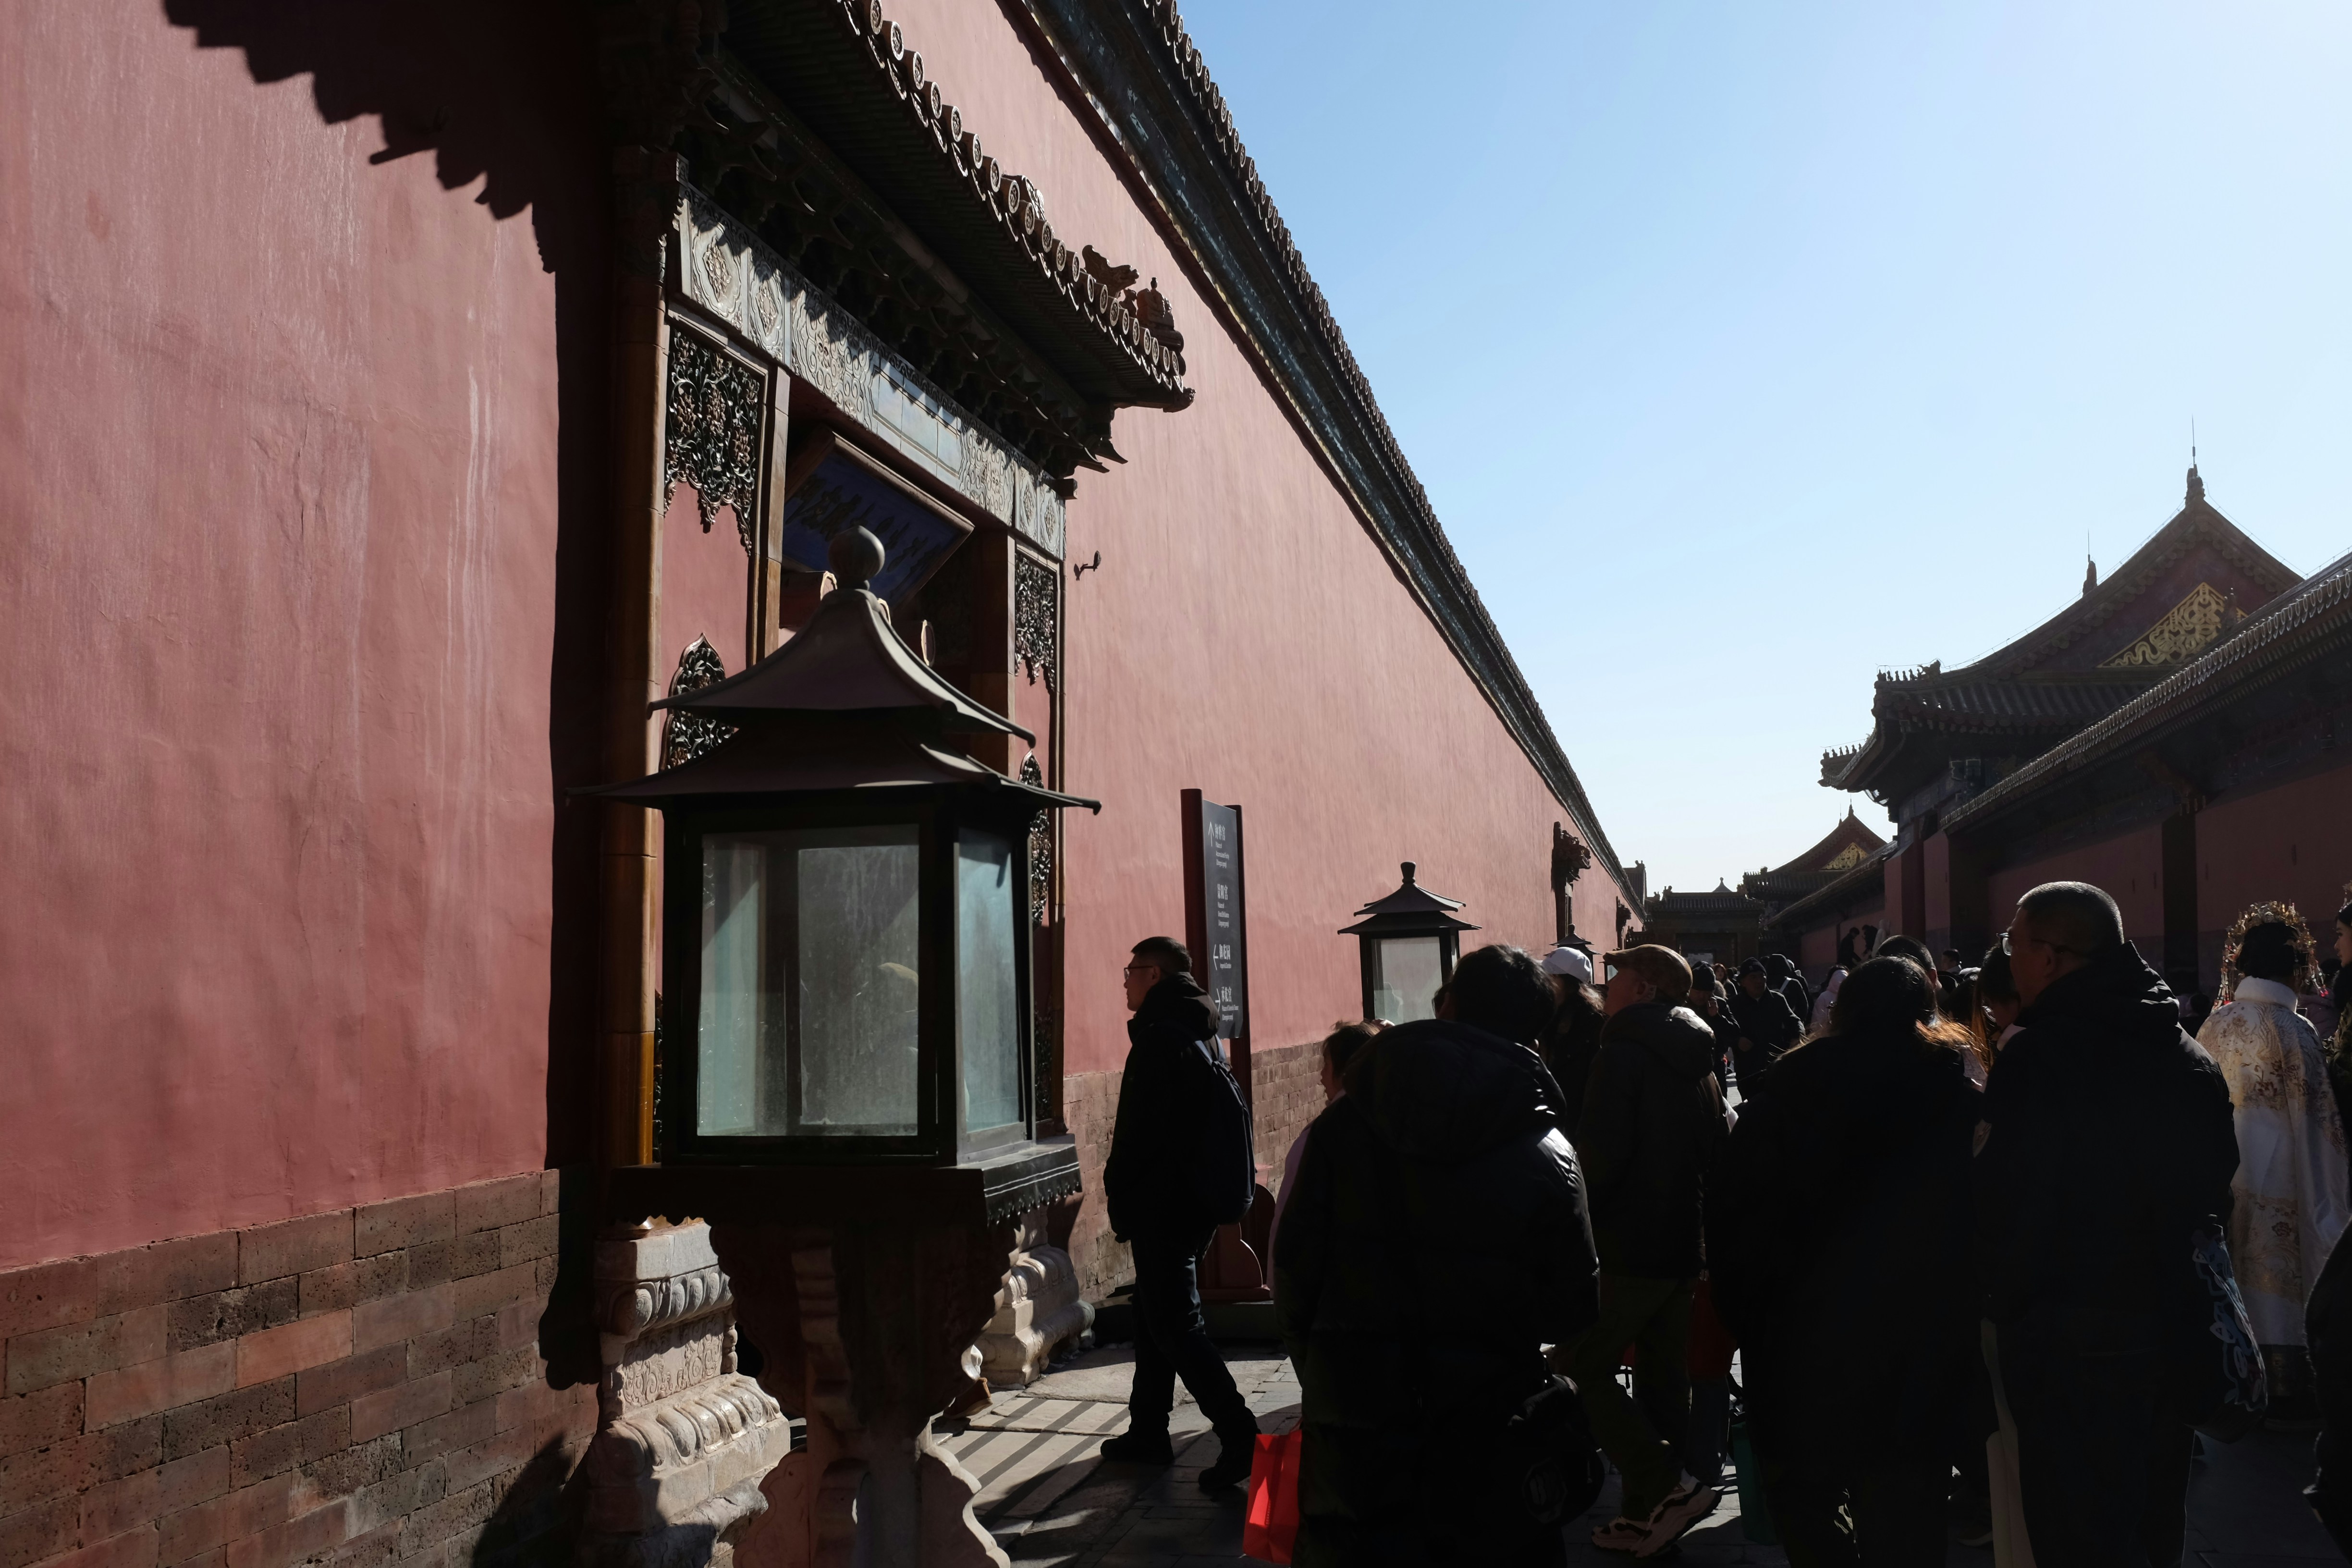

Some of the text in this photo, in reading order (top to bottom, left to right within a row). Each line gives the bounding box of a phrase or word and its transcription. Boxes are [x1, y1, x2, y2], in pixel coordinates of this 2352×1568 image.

[1214, 823, 1225, 841] 钟粹宫
[1217, 883, 1228, 900] 景阳宫
[1219, 944, 1231, 960] 御花园
[1221, 986, 1232, 1002] 承乾宫
